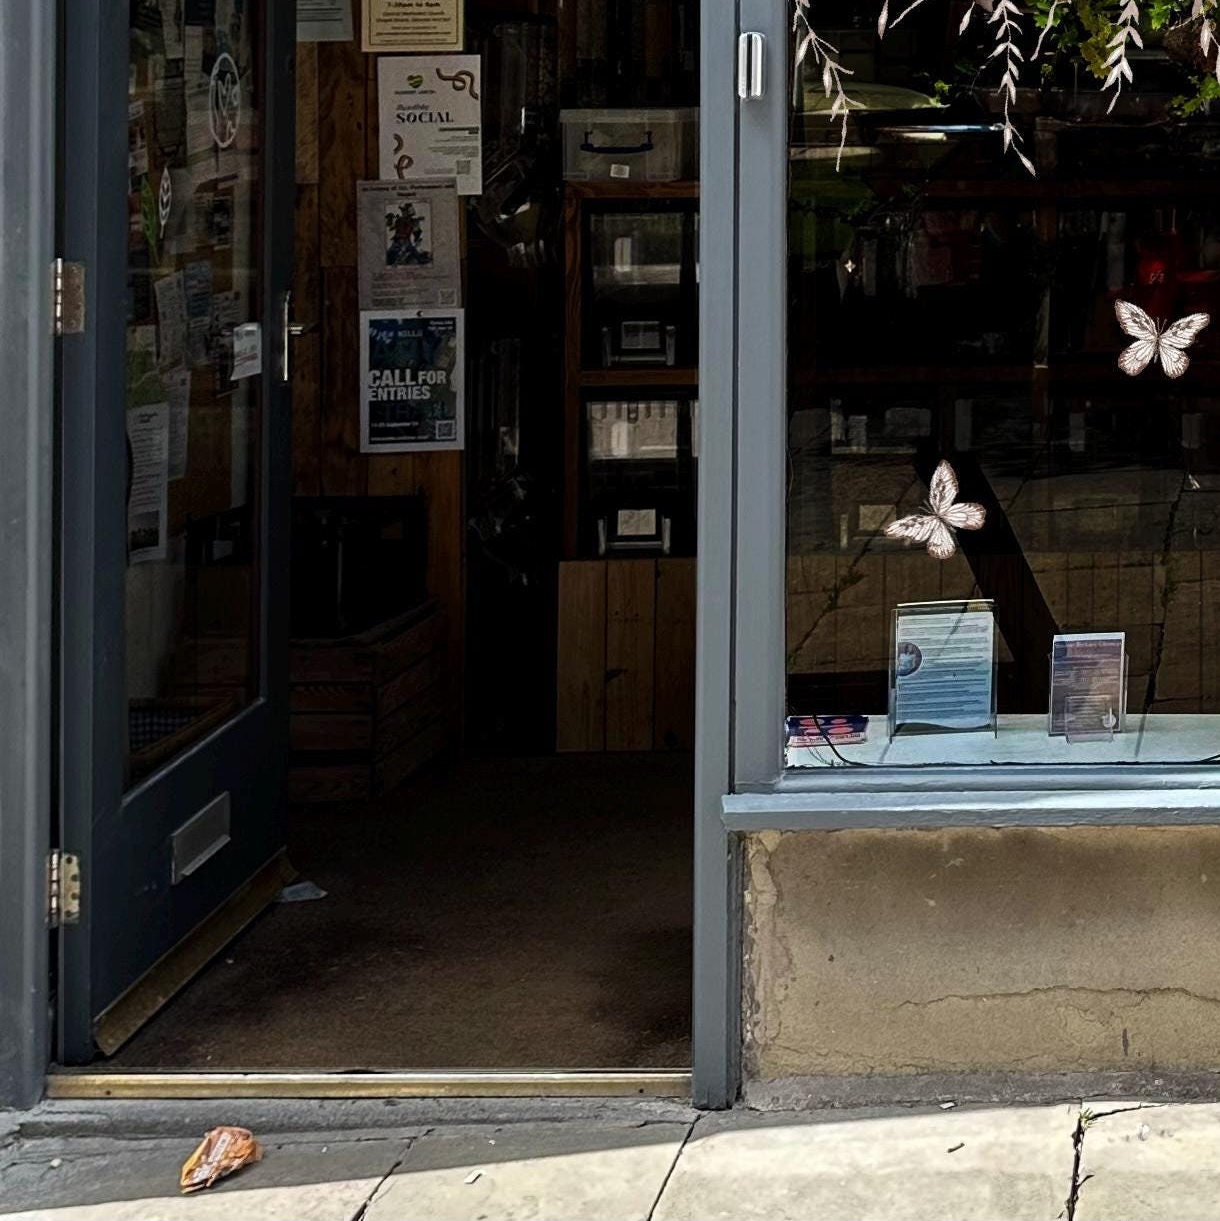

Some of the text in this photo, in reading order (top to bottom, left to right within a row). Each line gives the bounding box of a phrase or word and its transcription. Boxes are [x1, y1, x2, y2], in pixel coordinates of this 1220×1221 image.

[396, 111, 454, 123] SOCIAL
[368, 369, 447, 386] CALL FOR
[368, 386, 432, 401] ENTRIES
